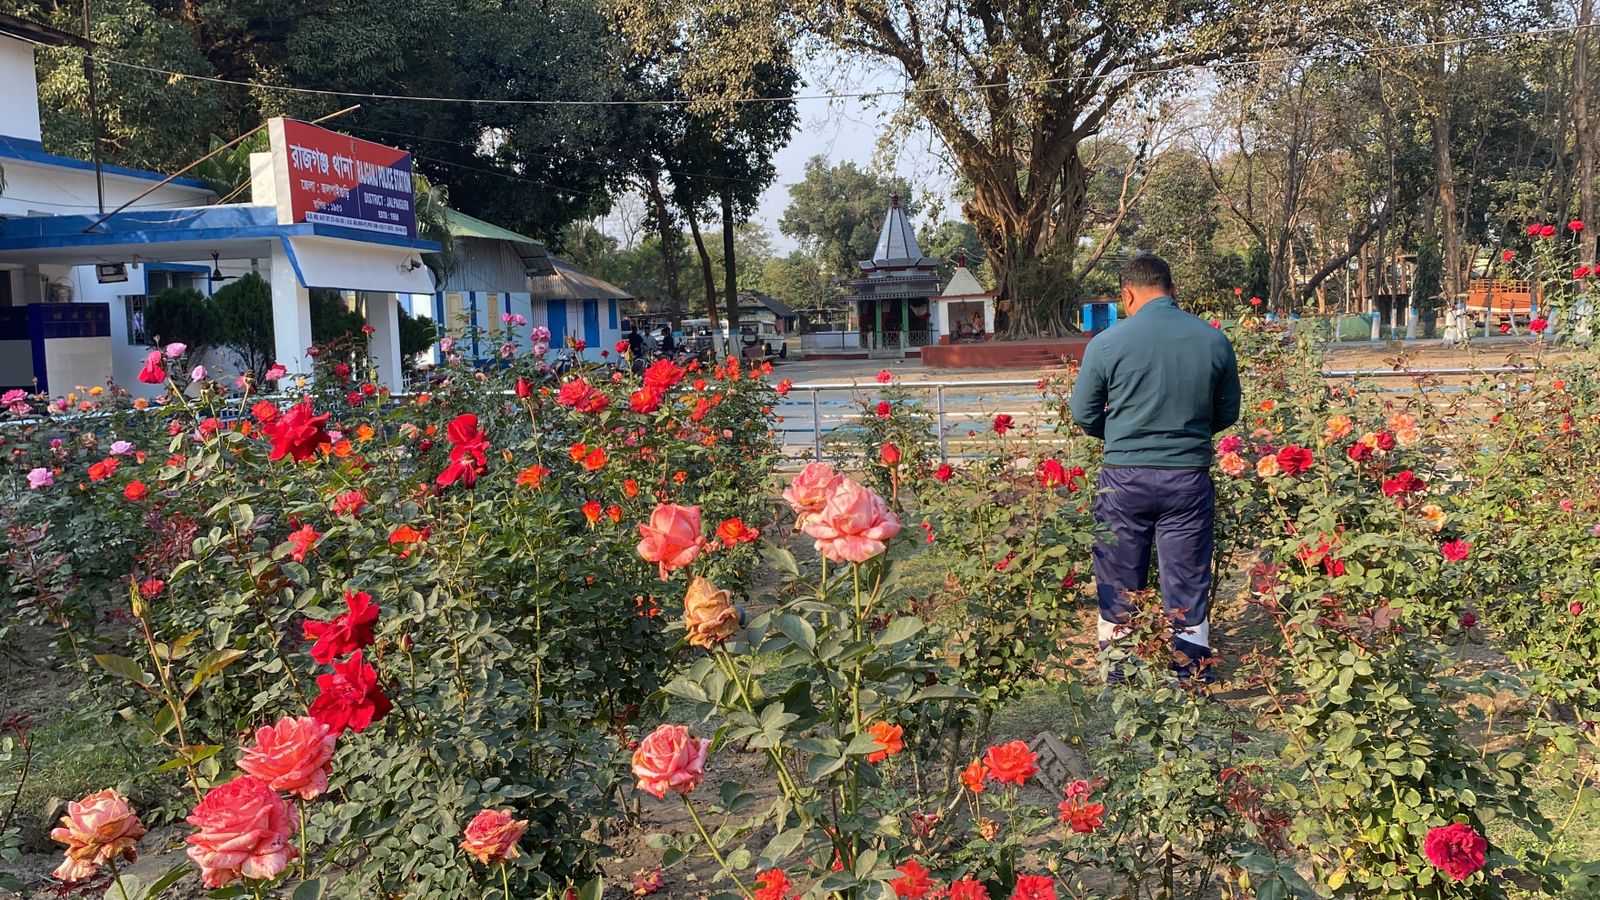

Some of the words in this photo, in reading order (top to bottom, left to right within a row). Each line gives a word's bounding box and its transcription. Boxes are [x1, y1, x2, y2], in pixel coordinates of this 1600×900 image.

[289, 143, 330, 176] রাজগঞ্জ
[332, 152, 354, 181] থানা
[357, 160, 378, 187] RAJGANJ
[377, 165, 394, 190] POLICE
[393, 169, 411, 194] STATION
[364, 192, 383, 207] DISTRICT
